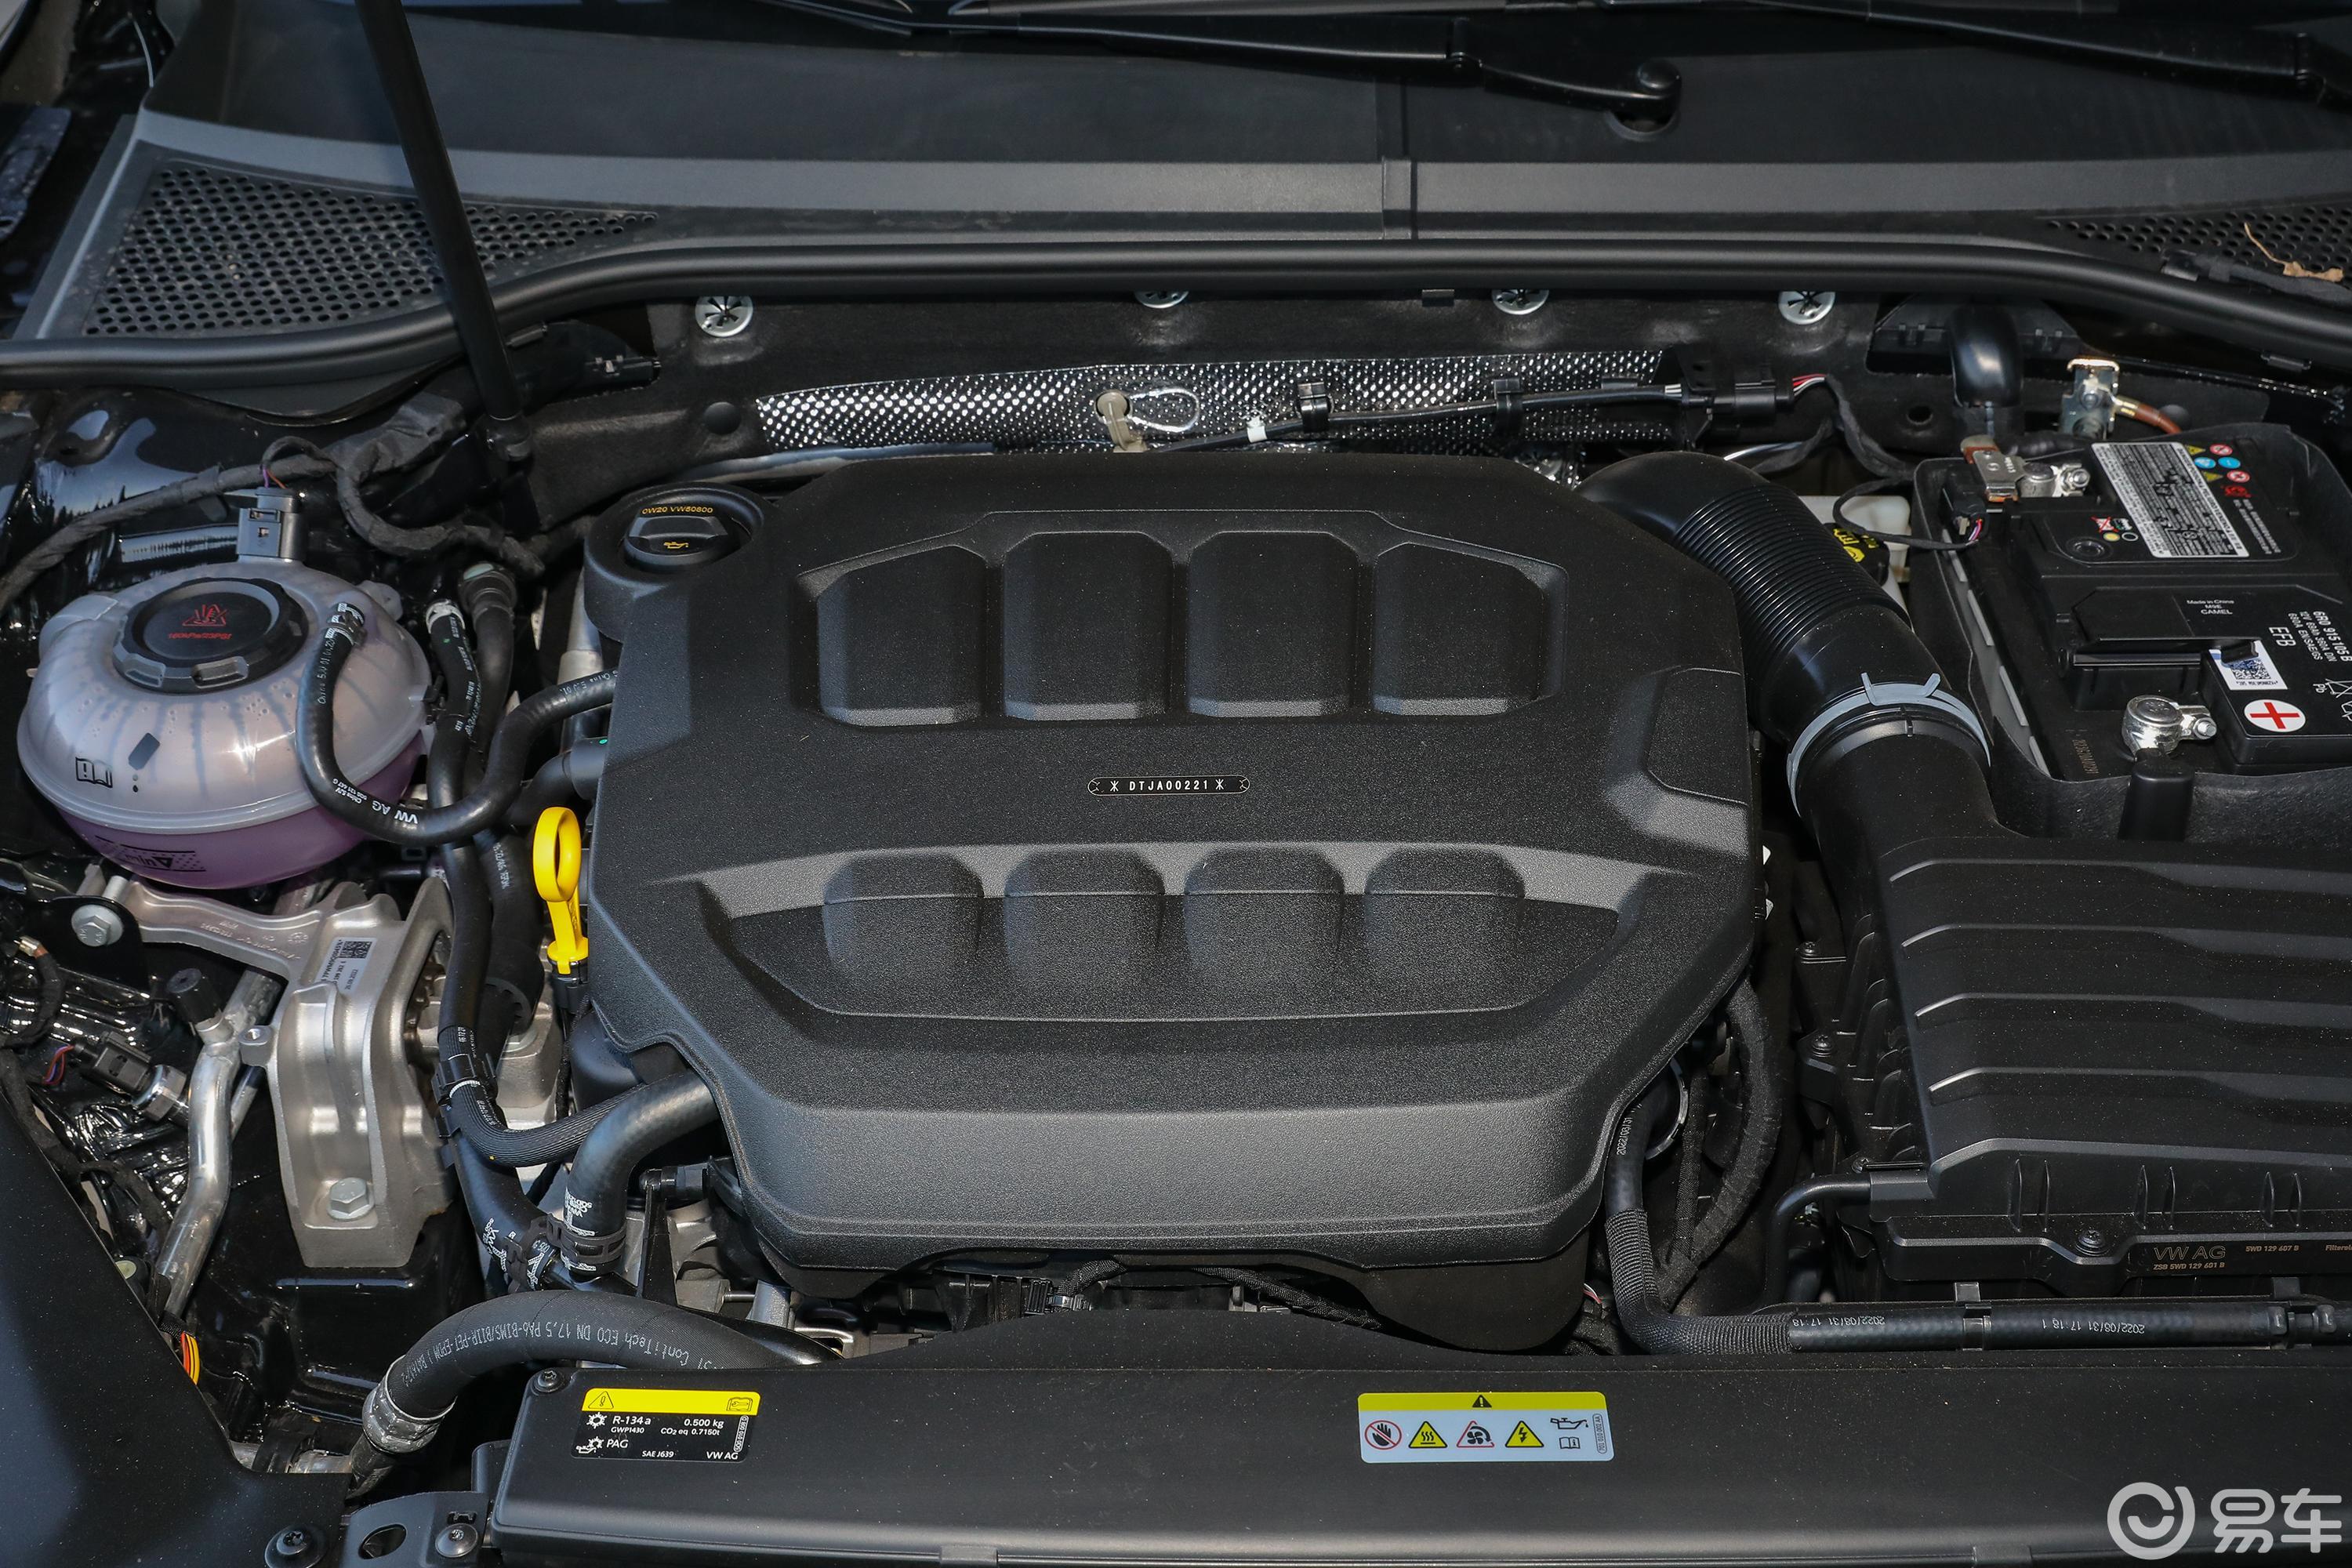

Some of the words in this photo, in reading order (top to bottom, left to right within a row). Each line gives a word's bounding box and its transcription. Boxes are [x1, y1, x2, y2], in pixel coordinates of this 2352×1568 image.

[2269, 626, 2297, 647] EFB
[2323, 627, 2342, 641] 915
[2332, 641, 2350, 655] 105
[2324, 652, 2338, 662] DIN
[2313, 684, 2328, 693] Pb
[1129, 779, 1208, 791] DTJA00221
[372, 800, 391, 815] AG
[394, 810, 418, 824] VW
[2153, 1247, 2190, 1260] VW
[2192, 1245, 2227, 1260] AG
[576, 1323, 591, 1341] DN
[597, 1327, 619, 1345] ECO
[684, 1418, 710, 1427] 0.500
[713, 1419, 724, 1428] kg
[607, 1439, 628, 1448] PAG
[706, 1451, 723, 1460] VW
